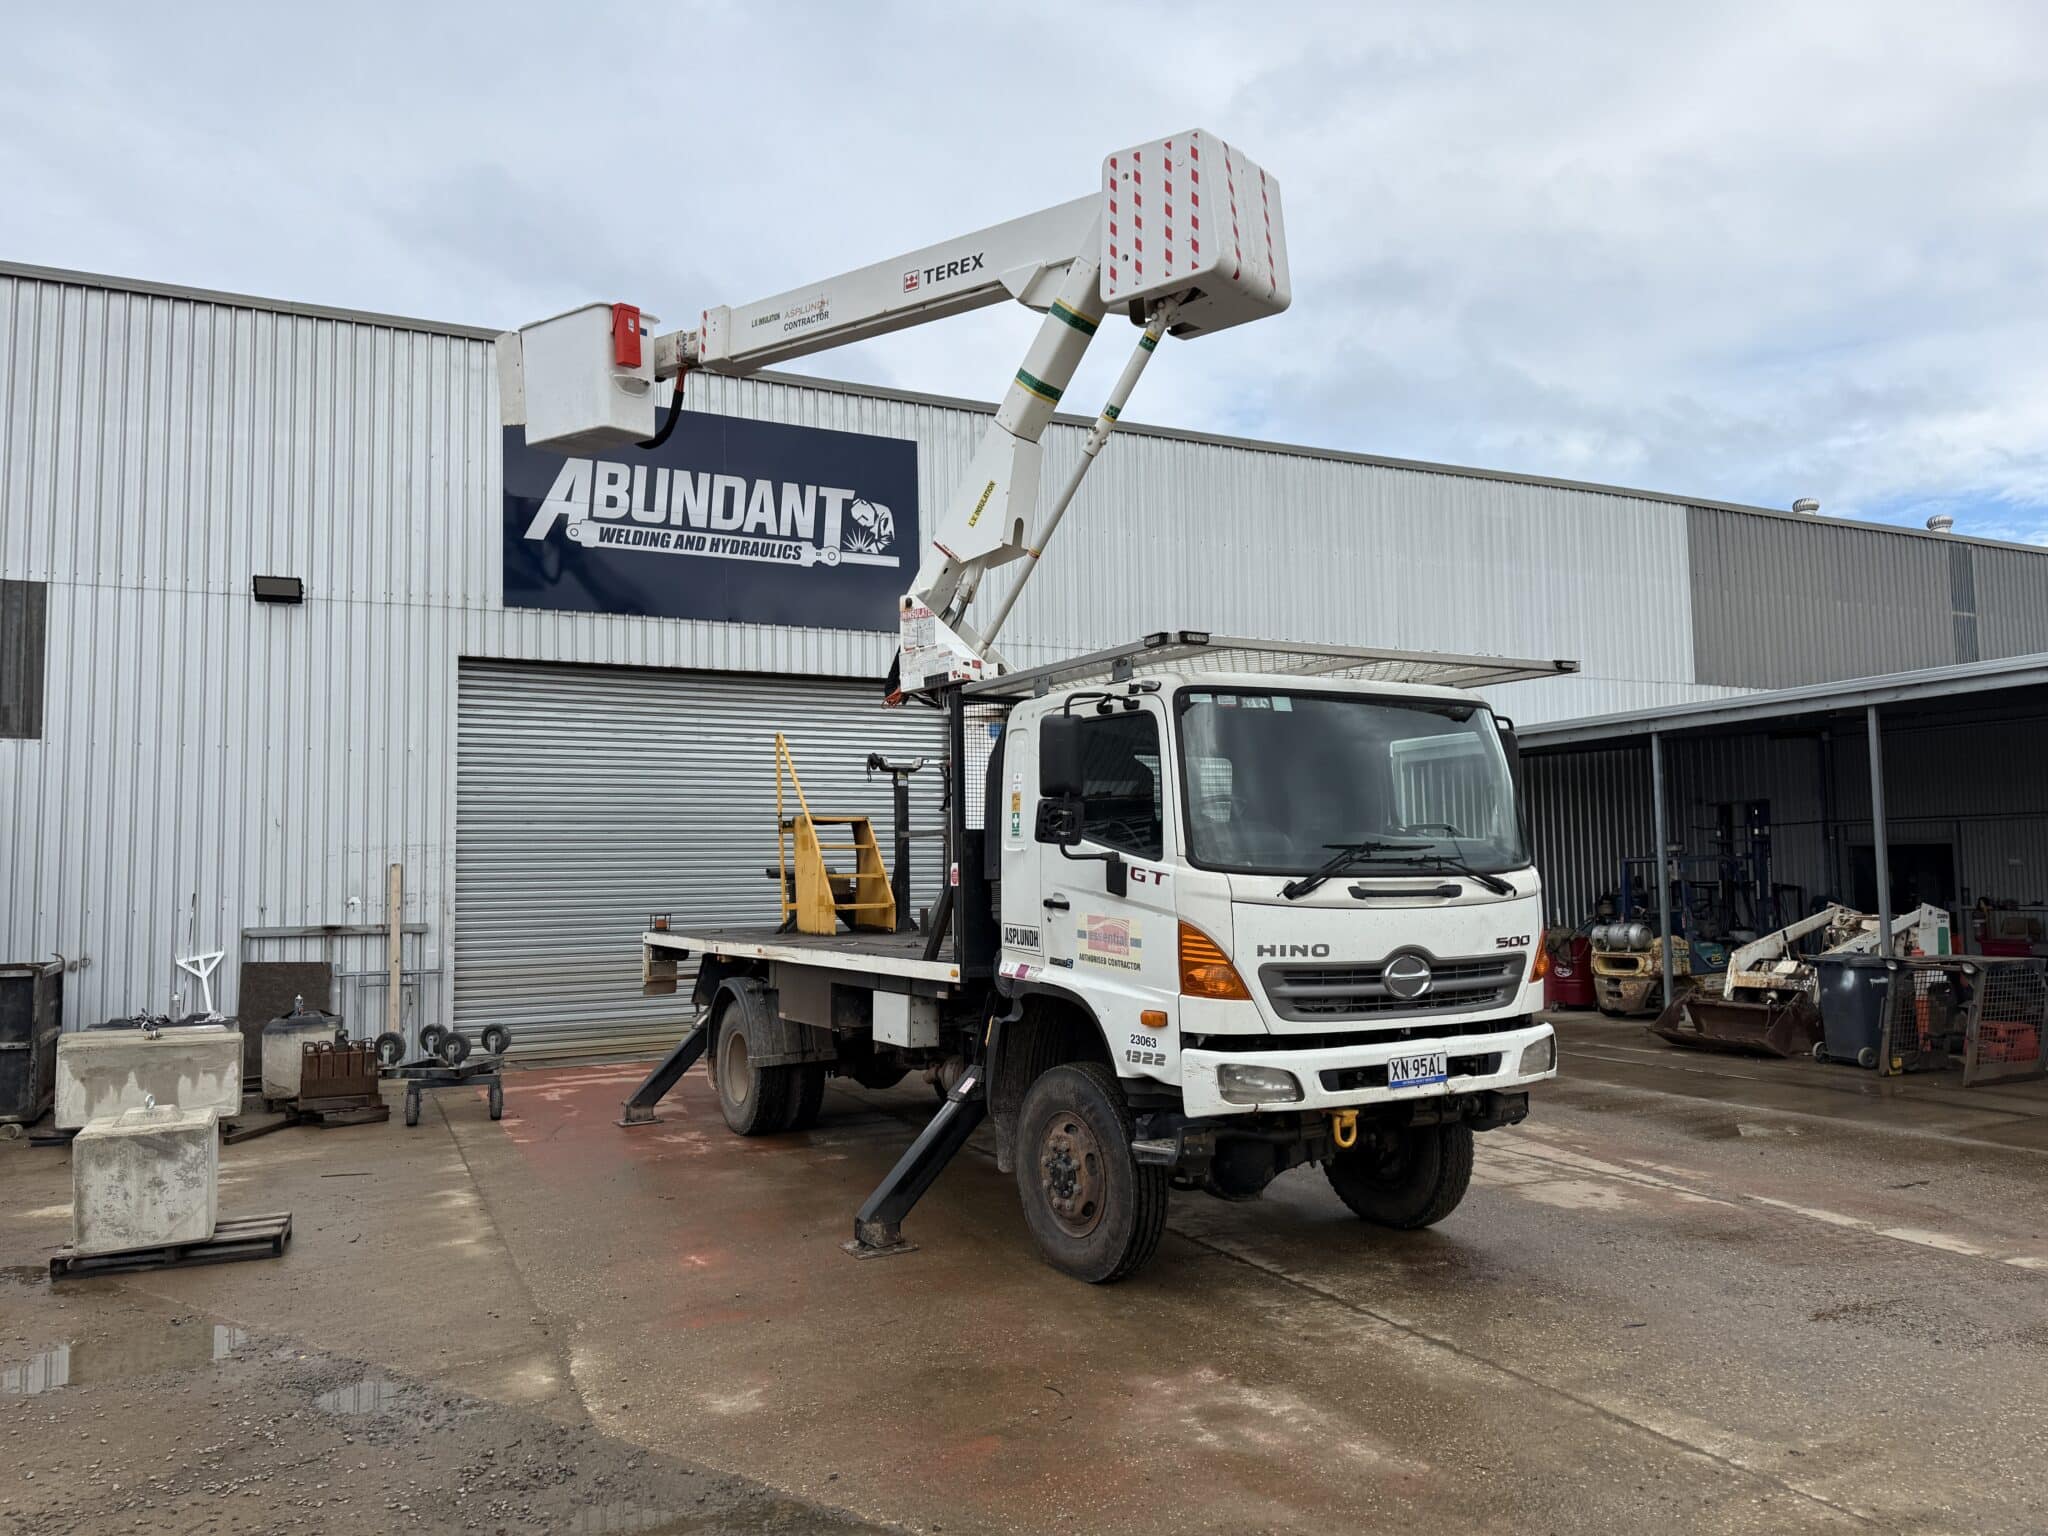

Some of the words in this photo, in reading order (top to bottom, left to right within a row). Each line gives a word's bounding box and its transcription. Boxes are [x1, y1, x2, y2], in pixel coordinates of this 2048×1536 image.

[923, 252, 984, 285] TEREX
[783, 310, 829, 332] CONTRACTOR
[523, 457, 856, 548] ABUNDANT
[599, 527, 671, 549] WELDING
[673, 536, 706, 552] AND
[709, 537, 802, 561] HYDRAULICS
[1130, 866, 1170, 885] GT
[1004, 927, 1039, 948] ASPLUNDH
[1495, 934, 1530, 948] 500
[1257, 944, 1330, 958] HINO
[1107, 957, 1142, 971] CONTRACTOR
[1130, 1033, 1158, 1049] 23063
[1126, 1049, 1167, 1067] 1322
